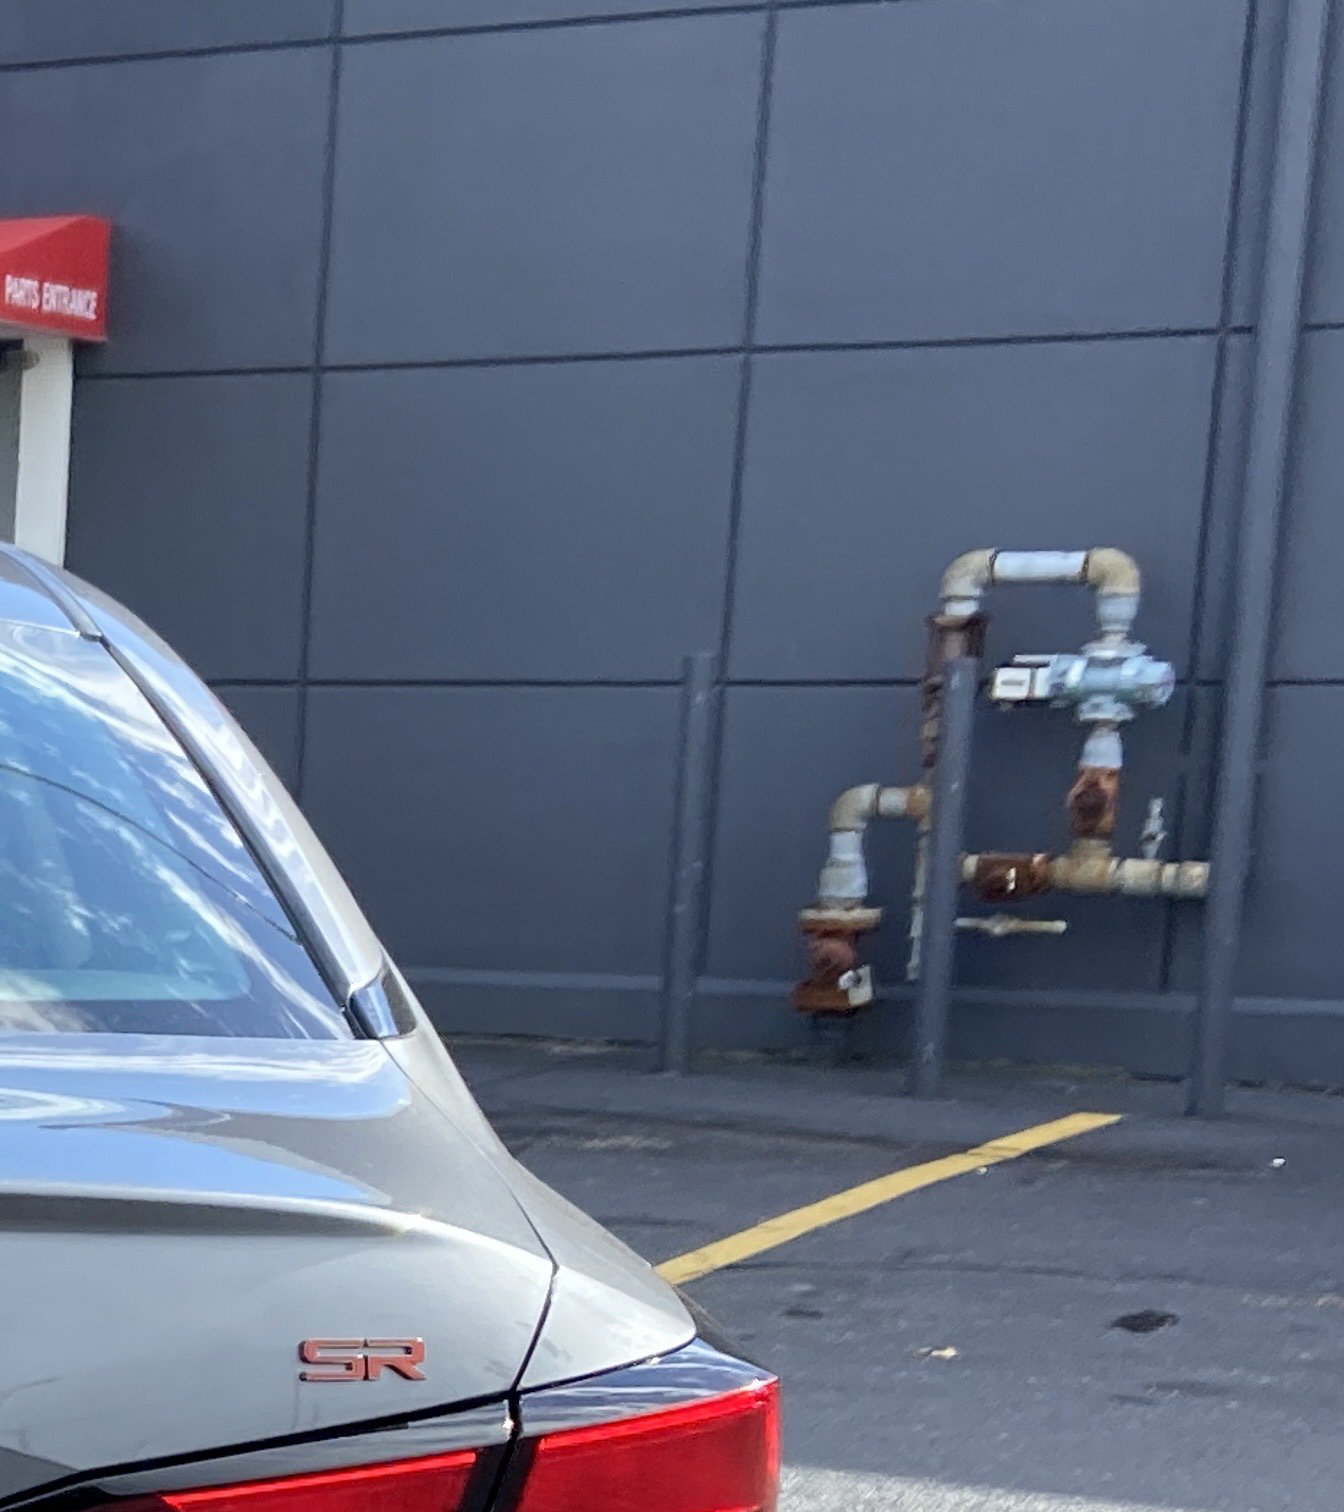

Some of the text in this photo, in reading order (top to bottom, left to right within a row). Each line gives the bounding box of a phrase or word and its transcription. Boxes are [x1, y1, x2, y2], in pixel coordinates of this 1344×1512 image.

[5, 274, 98, 320] PARTS ENTRANCE
[298, 1336, 428, 1382] SR
